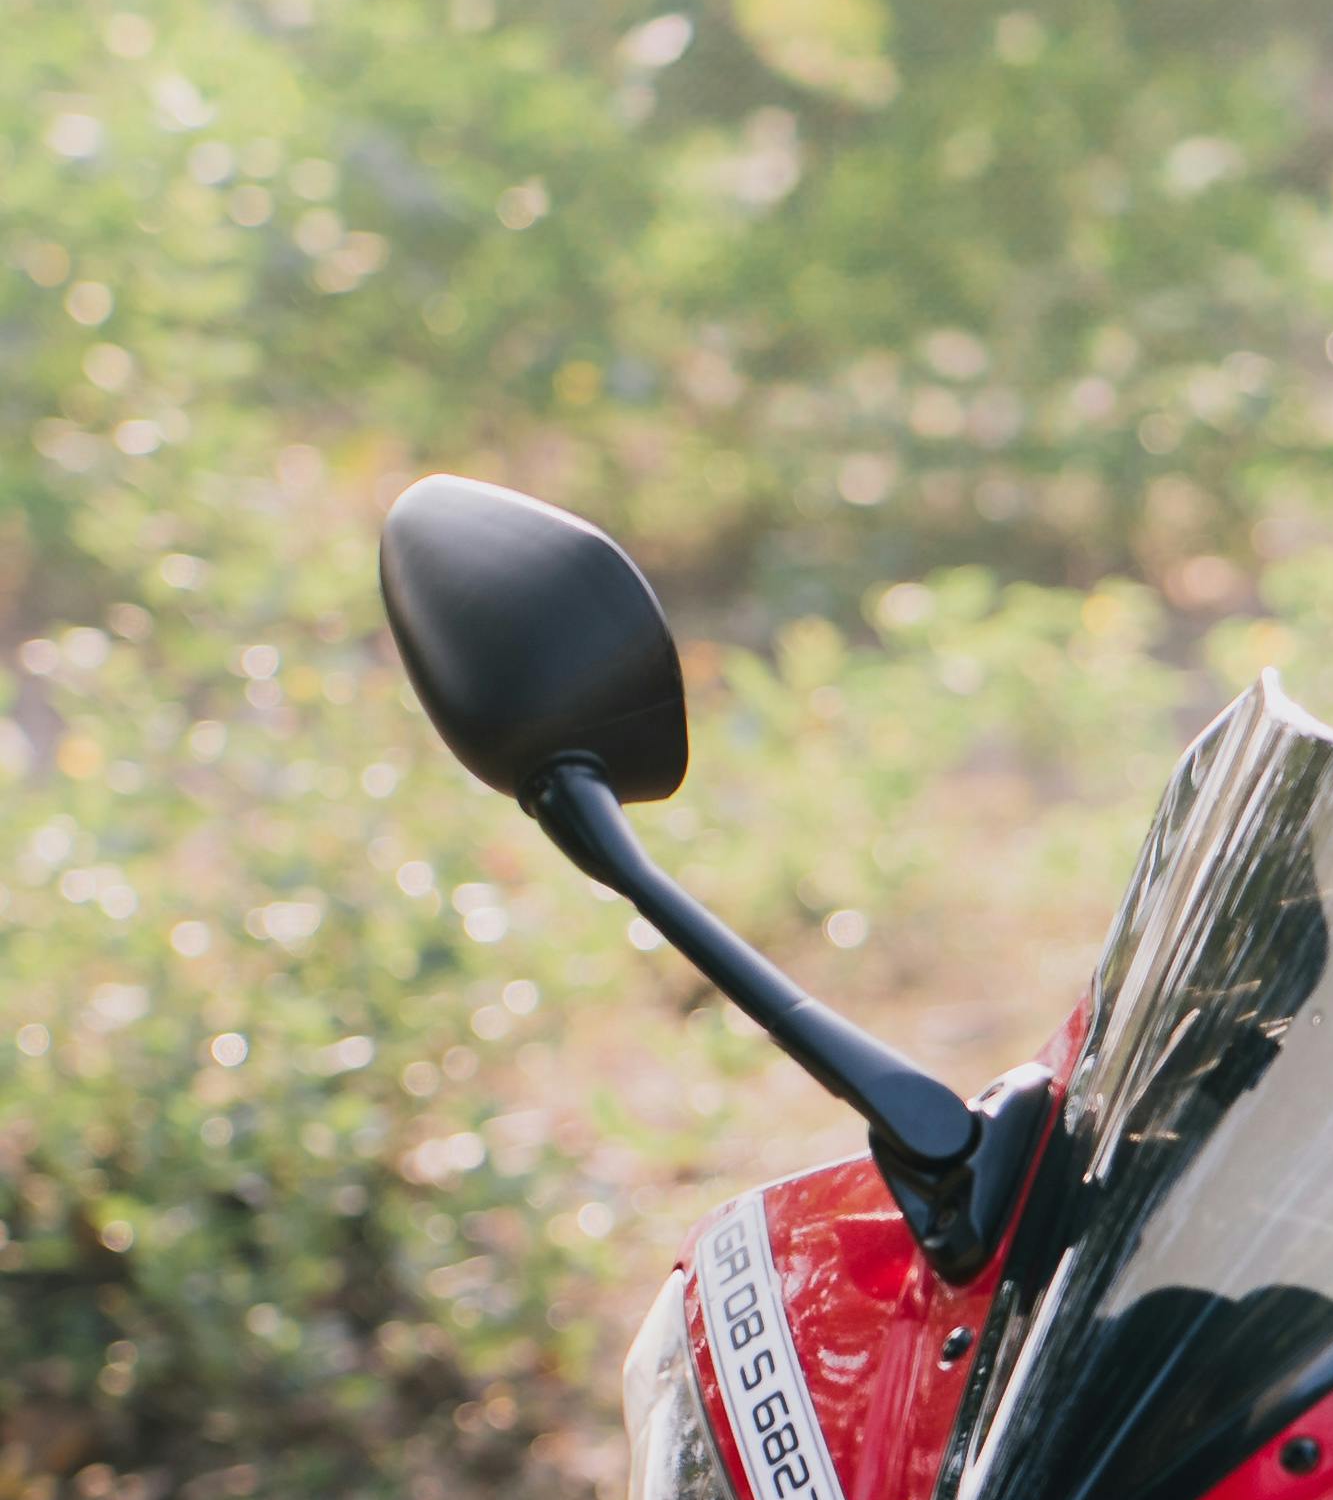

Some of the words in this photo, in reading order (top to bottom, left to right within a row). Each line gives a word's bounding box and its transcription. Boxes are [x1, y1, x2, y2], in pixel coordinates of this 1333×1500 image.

[714, 1220, 750, 1285] GA
[723, 1283, 765, 1350] 08
[741, 1349, 776, 1391] S
